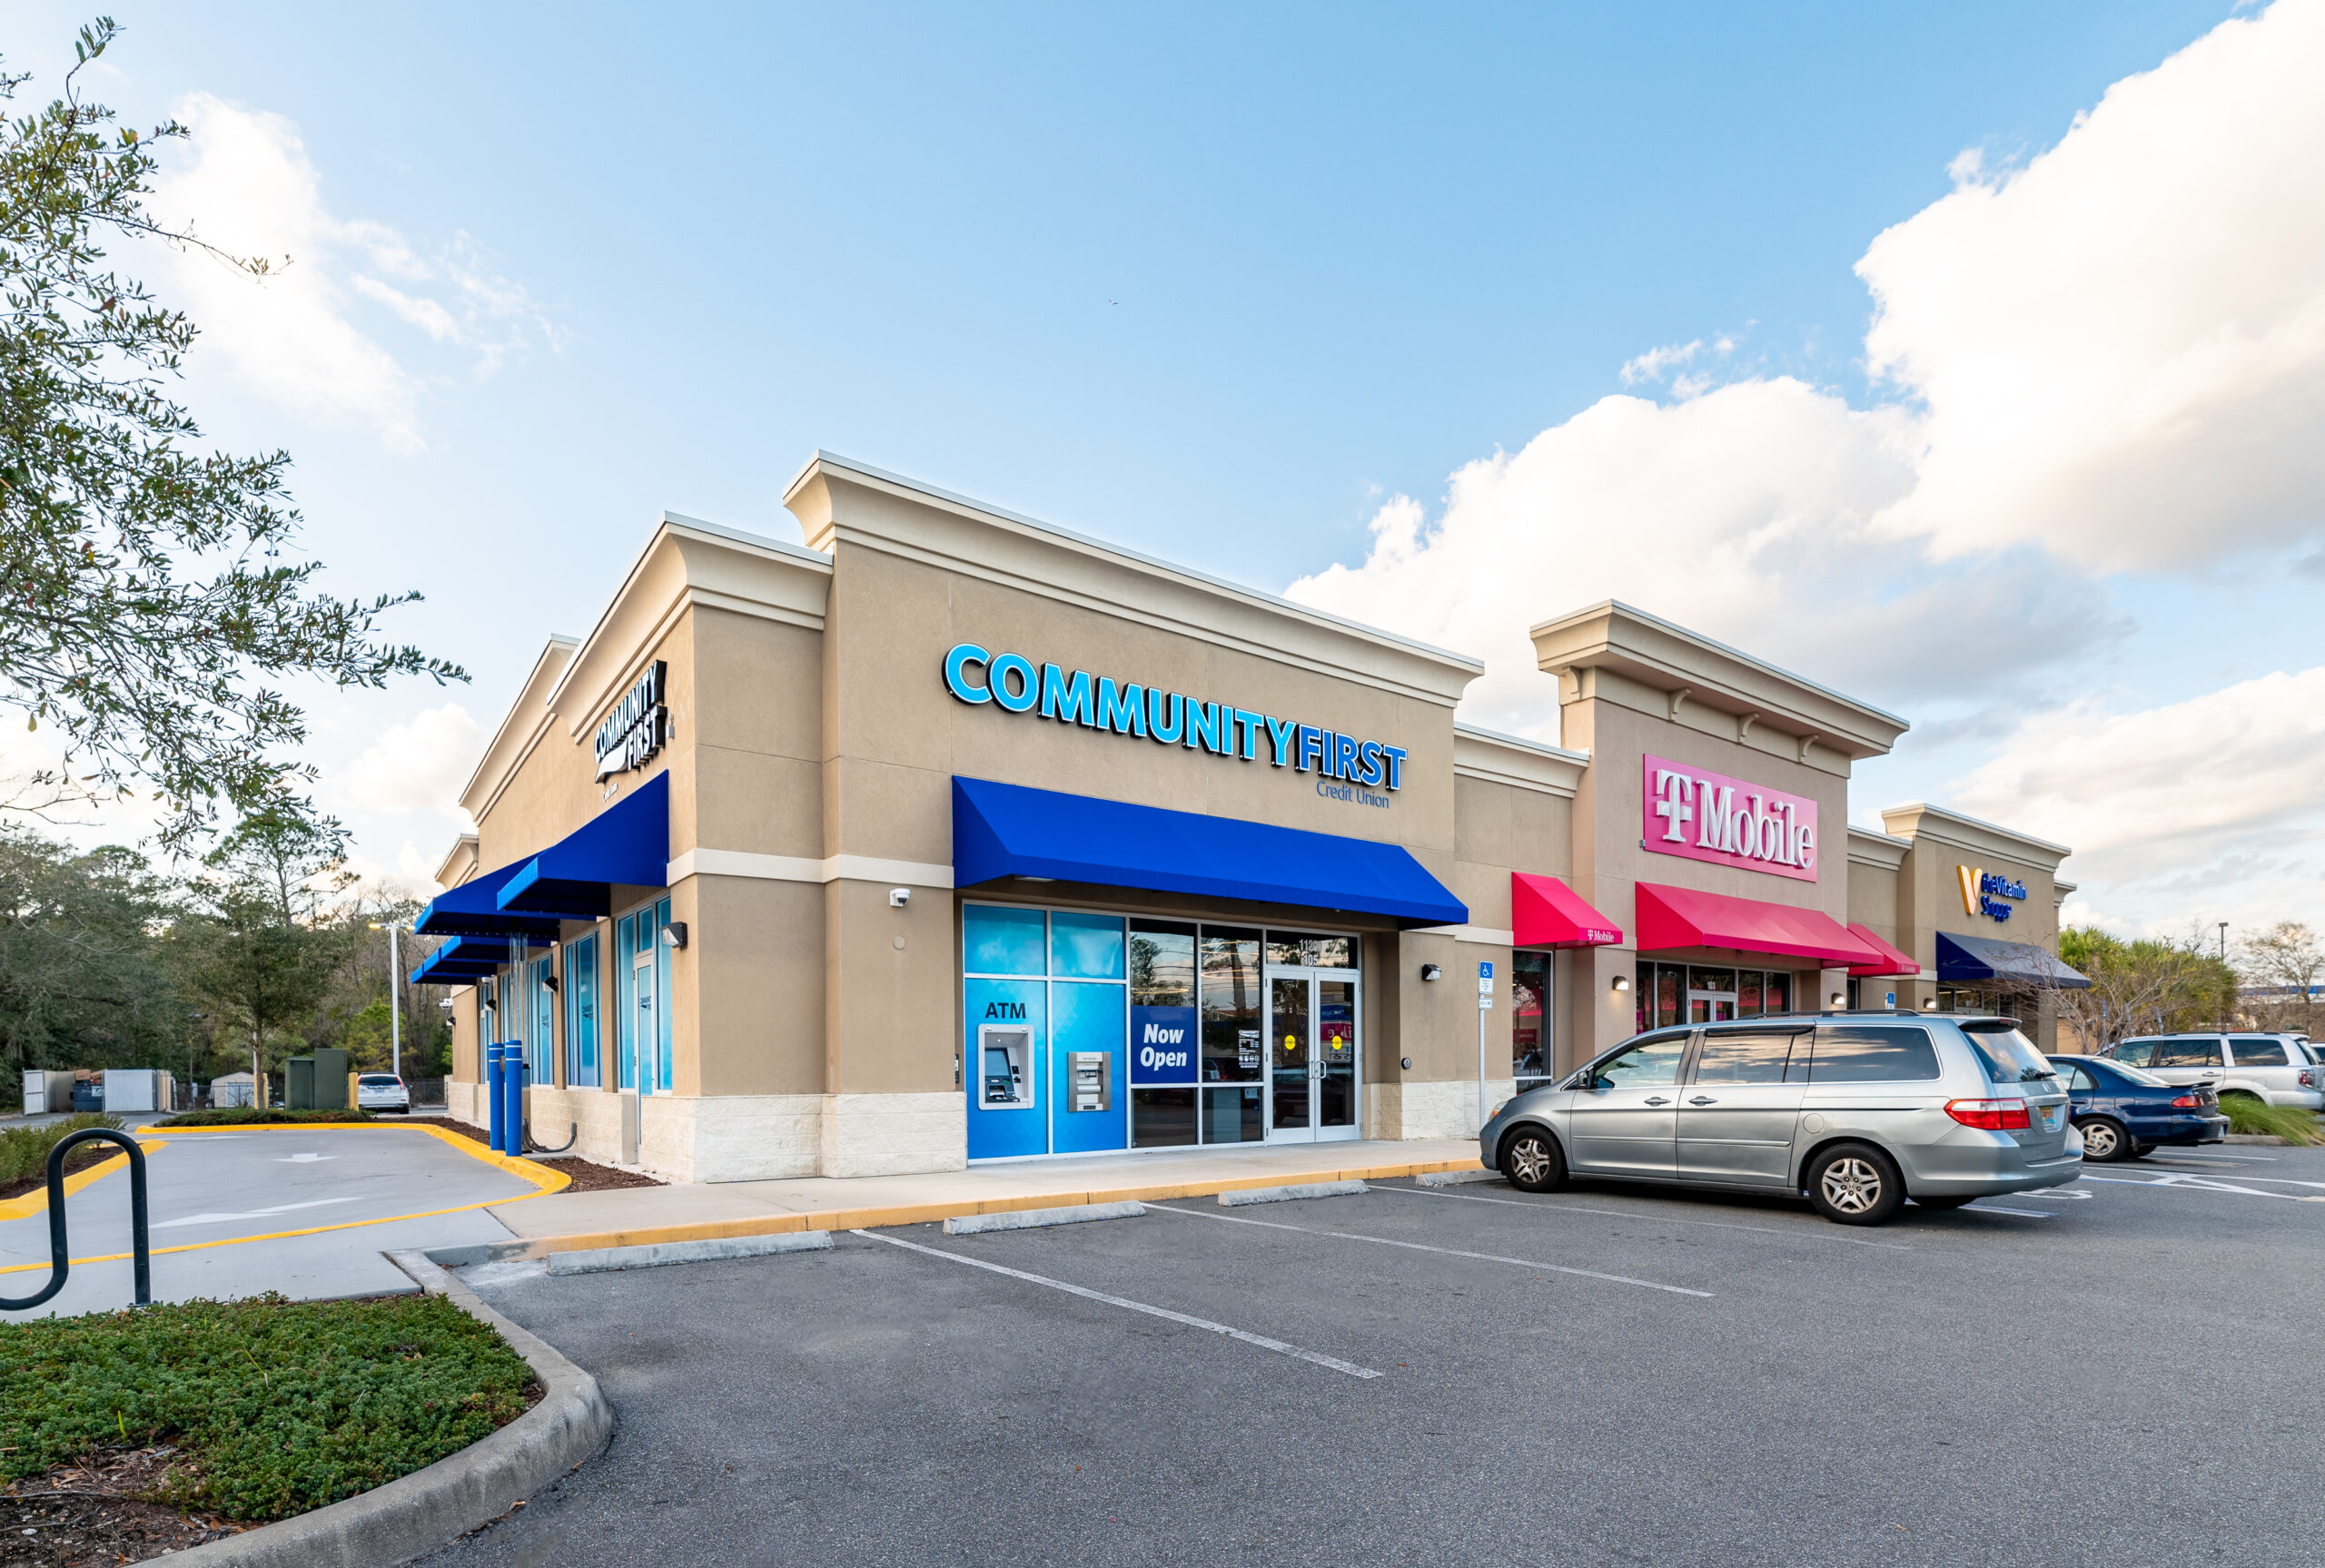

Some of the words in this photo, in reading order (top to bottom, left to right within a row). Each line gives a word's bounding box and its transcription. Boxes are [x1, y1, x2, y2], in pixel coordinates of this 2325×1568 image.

[594, 659, 665, 764] COMMUNITY
[627, 705, 665, 771] FIRST
[1317, 780, 1353, 803] Credit
[1357, 788, 1390, 809] Union
[1304, 953, 1318, 966] 105
[984, 1002, 1026, 1019] ATM
[1143, 1023, 1184, 1044] Now
[1140, 1046, 1187, 1071] Open
